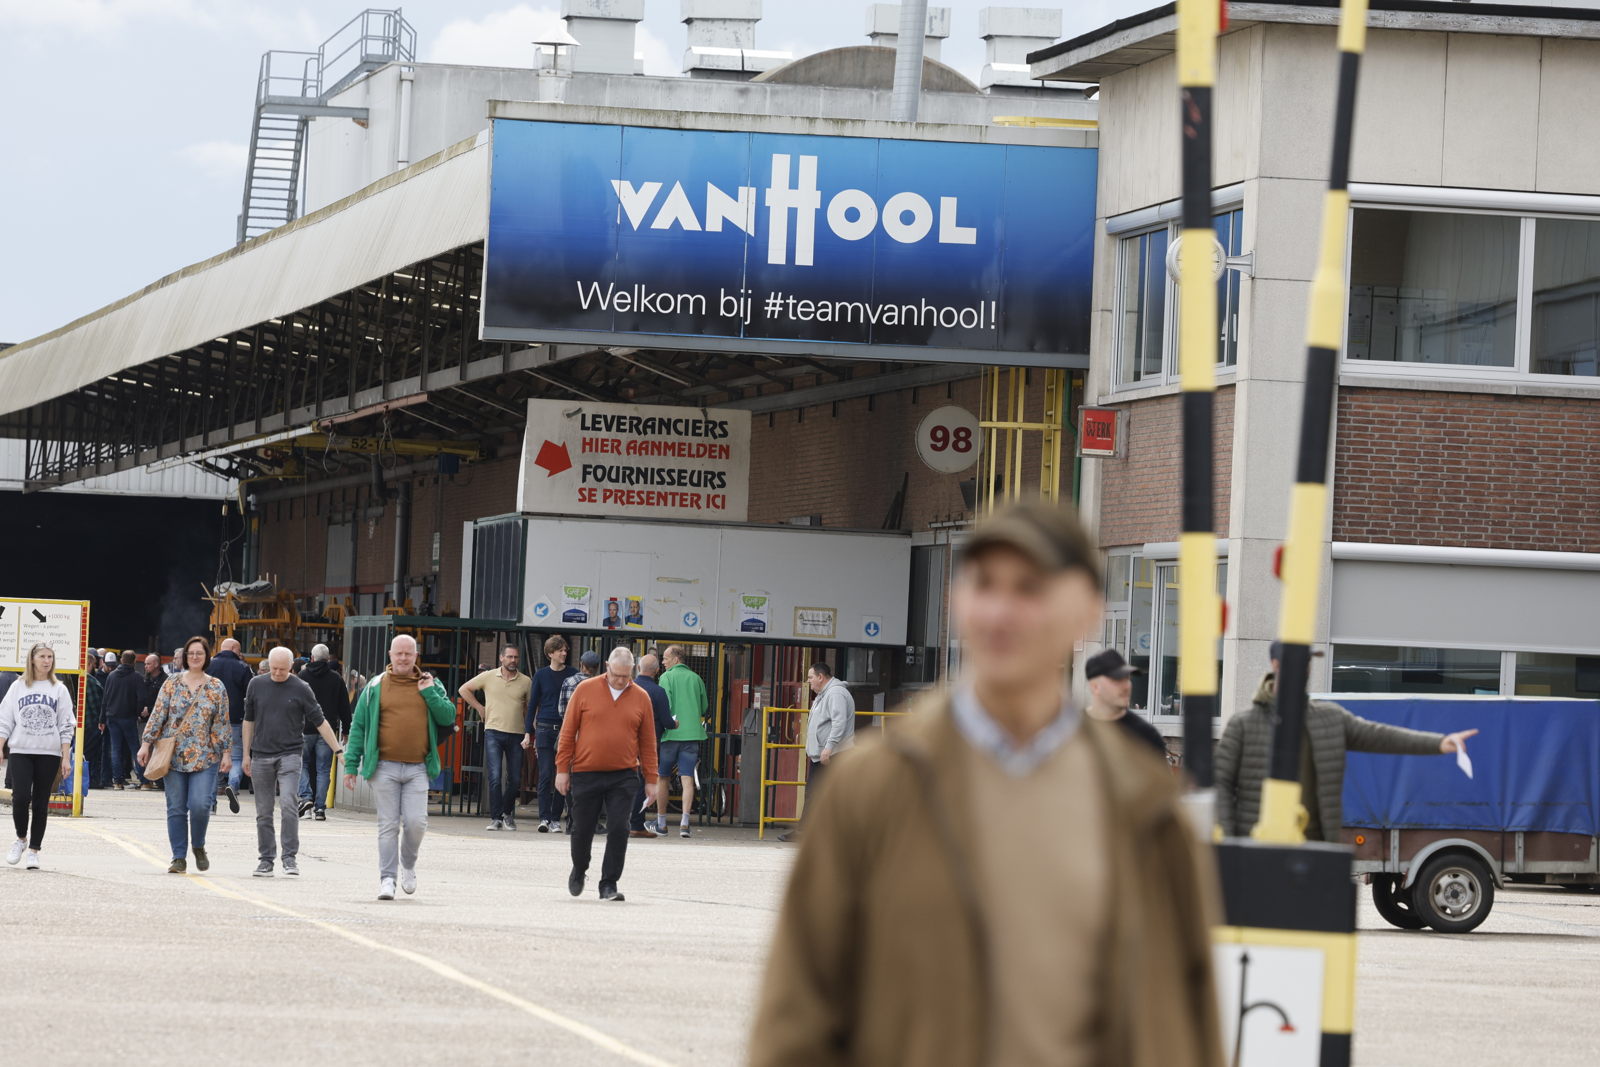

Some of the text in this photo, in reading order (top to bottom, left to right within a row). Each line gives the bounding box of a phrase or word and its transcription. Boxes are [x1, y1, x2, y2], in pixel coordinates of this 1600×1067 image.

[577, 281, 996, 329] Welkom bij #teamvanhool!
[580, 413, 729, 440] LEVERANCIERS
[930, 425, 972, 453] 98
[581, 437, 730, 460] HIER AANMELDEN
[582, 464, 727, 490] FOURNISSEURS
[578, 487, 726, 510] SE PRESENTER ICI
[18, 694, 57, 712] DREAM
